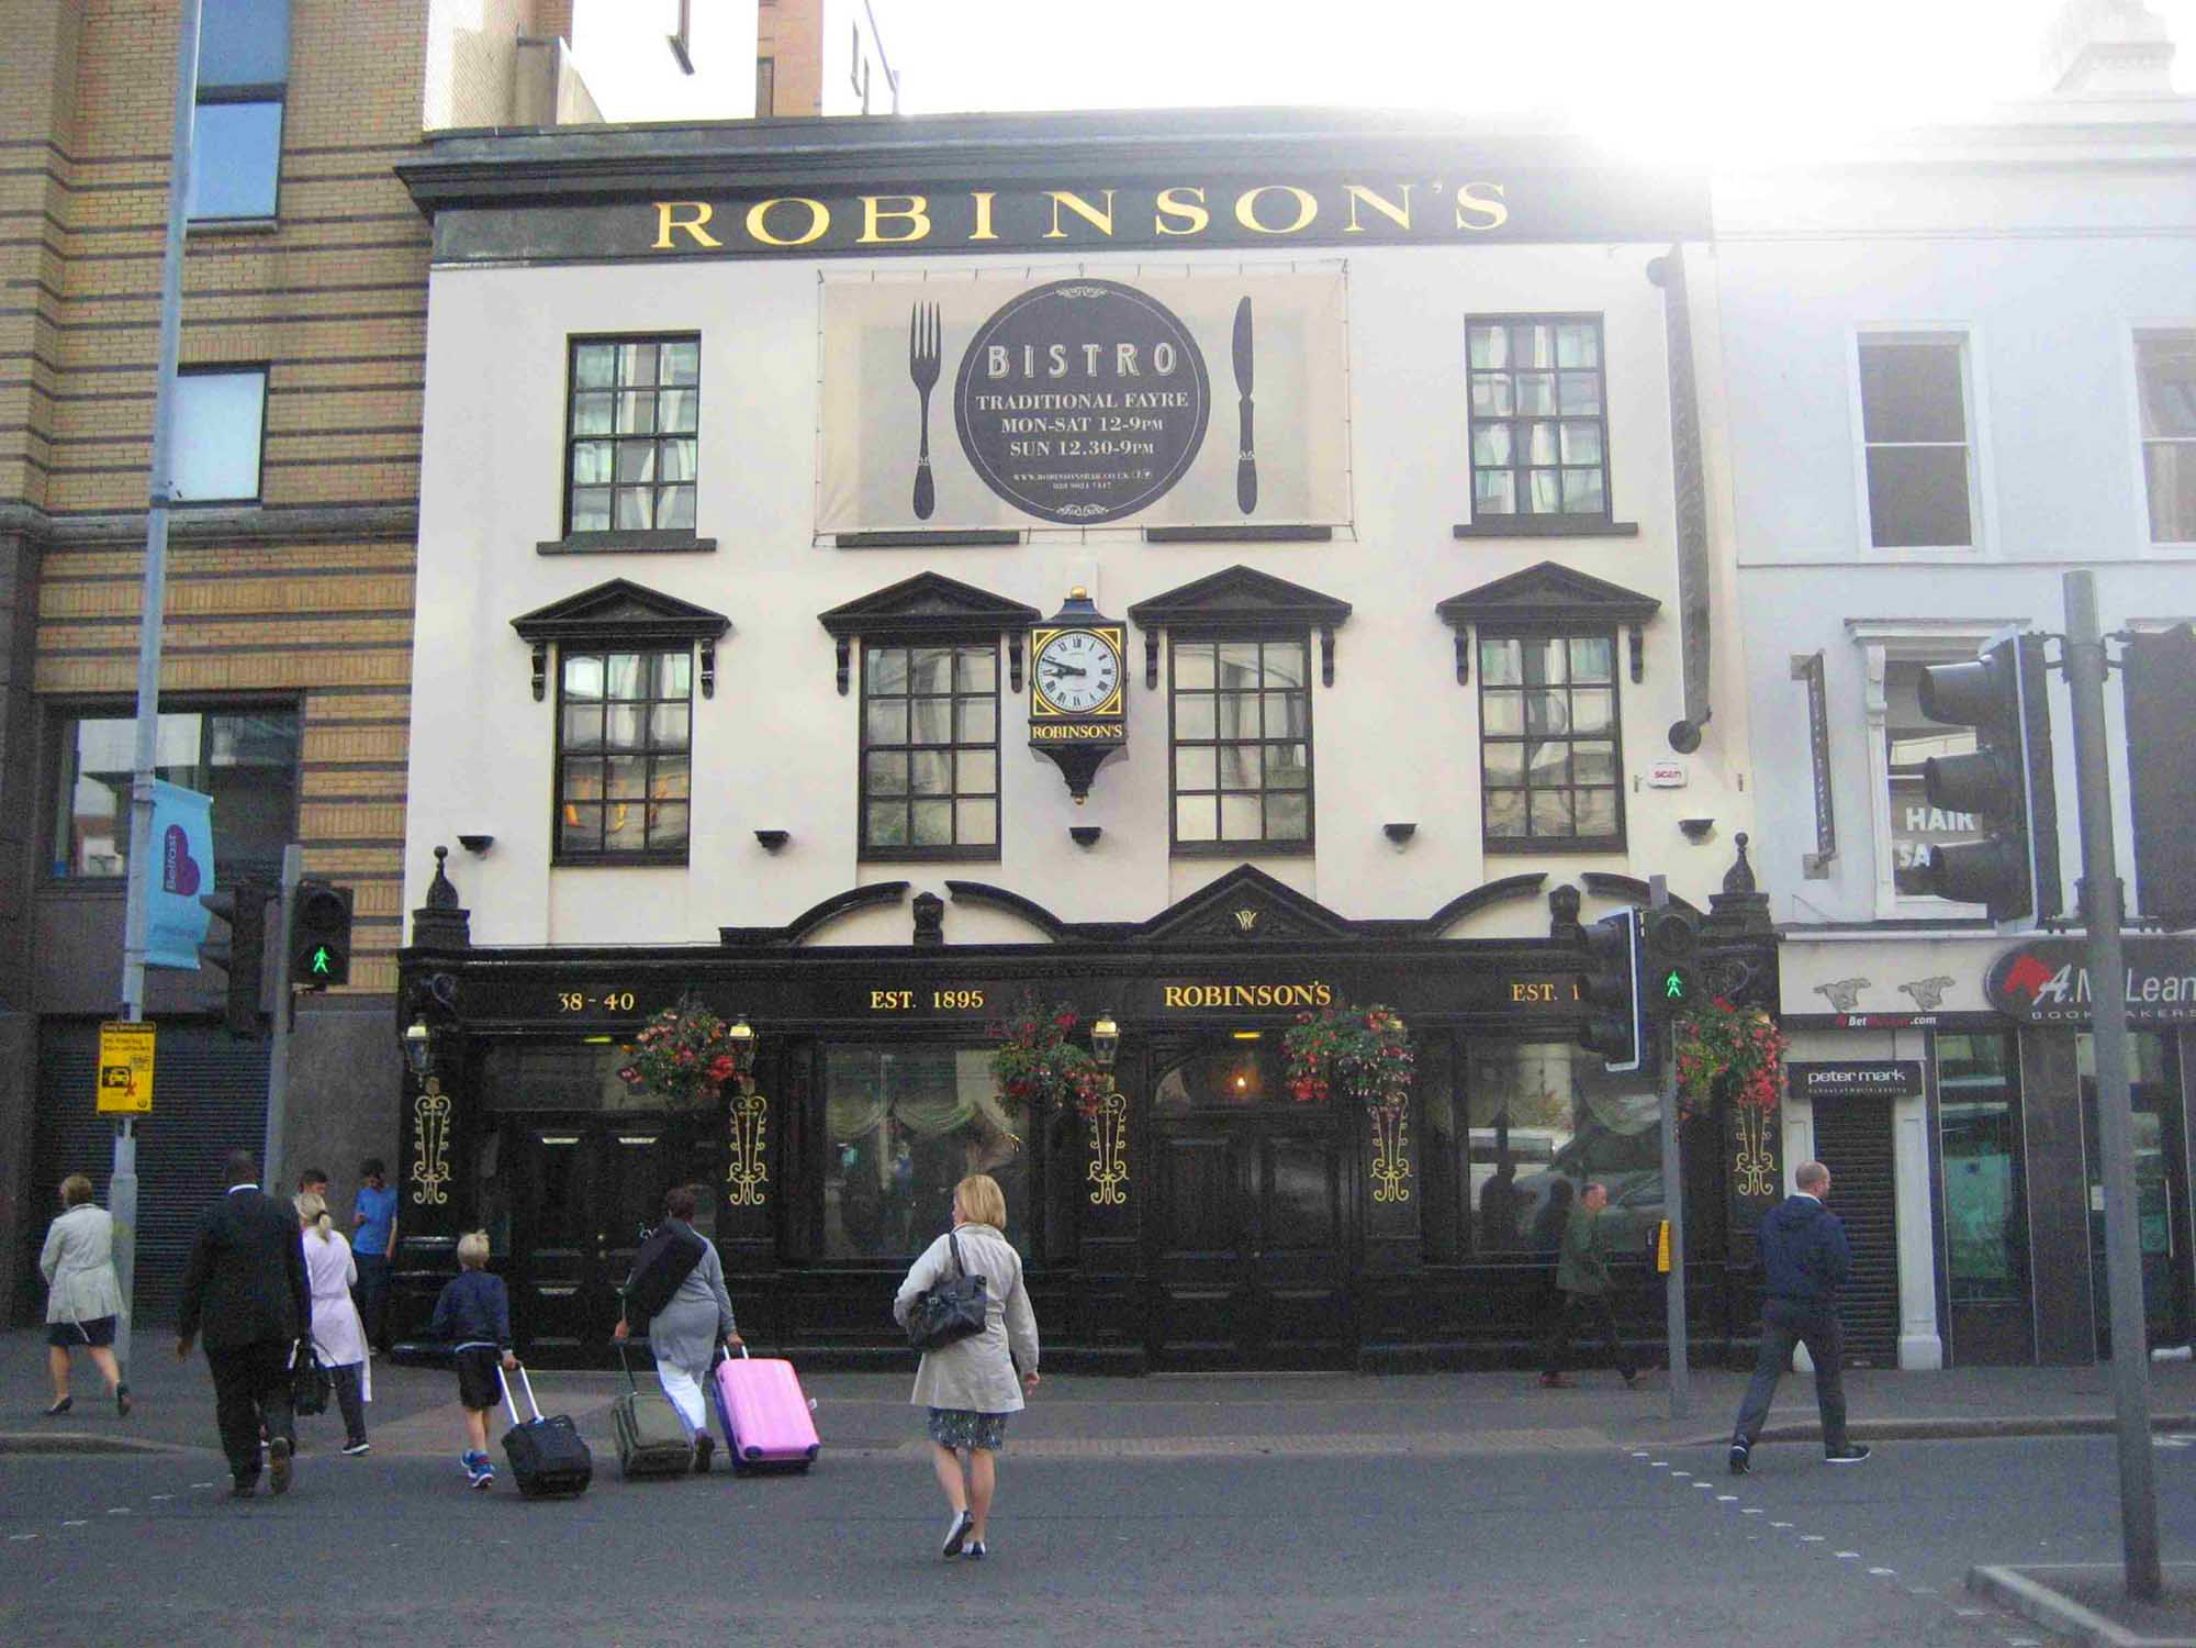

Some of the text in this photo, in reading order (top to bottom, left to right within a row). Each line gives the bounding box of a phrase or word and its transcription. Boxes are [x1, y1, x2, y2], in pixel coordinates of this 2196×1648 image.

[651, 182, 1509, 248] ROBINSON'S
[988, 343, 1176, 378] BISTRO
[976, 392, 1188, 410] TRADITIONAL FAYRE
[1001, 417, 1091, 433] MON-SAT
[1010, 441, 1049, 456] SUN
[1032, 724, 1122, 739] ROBINSON'S
[870, 990, 984, 1009] EST. 1895
[1164, 981, 1332, 1007] ROBINSON'S
[1512, 983, 1559, 1001] EST.
[558, 992, 582, 1012] 38
[603, 992, 635, 1011] 40
[2032, 1009, 2196, 1020] BOOKAKERS
[1808, 1069, 1905, 1085] peter mark
